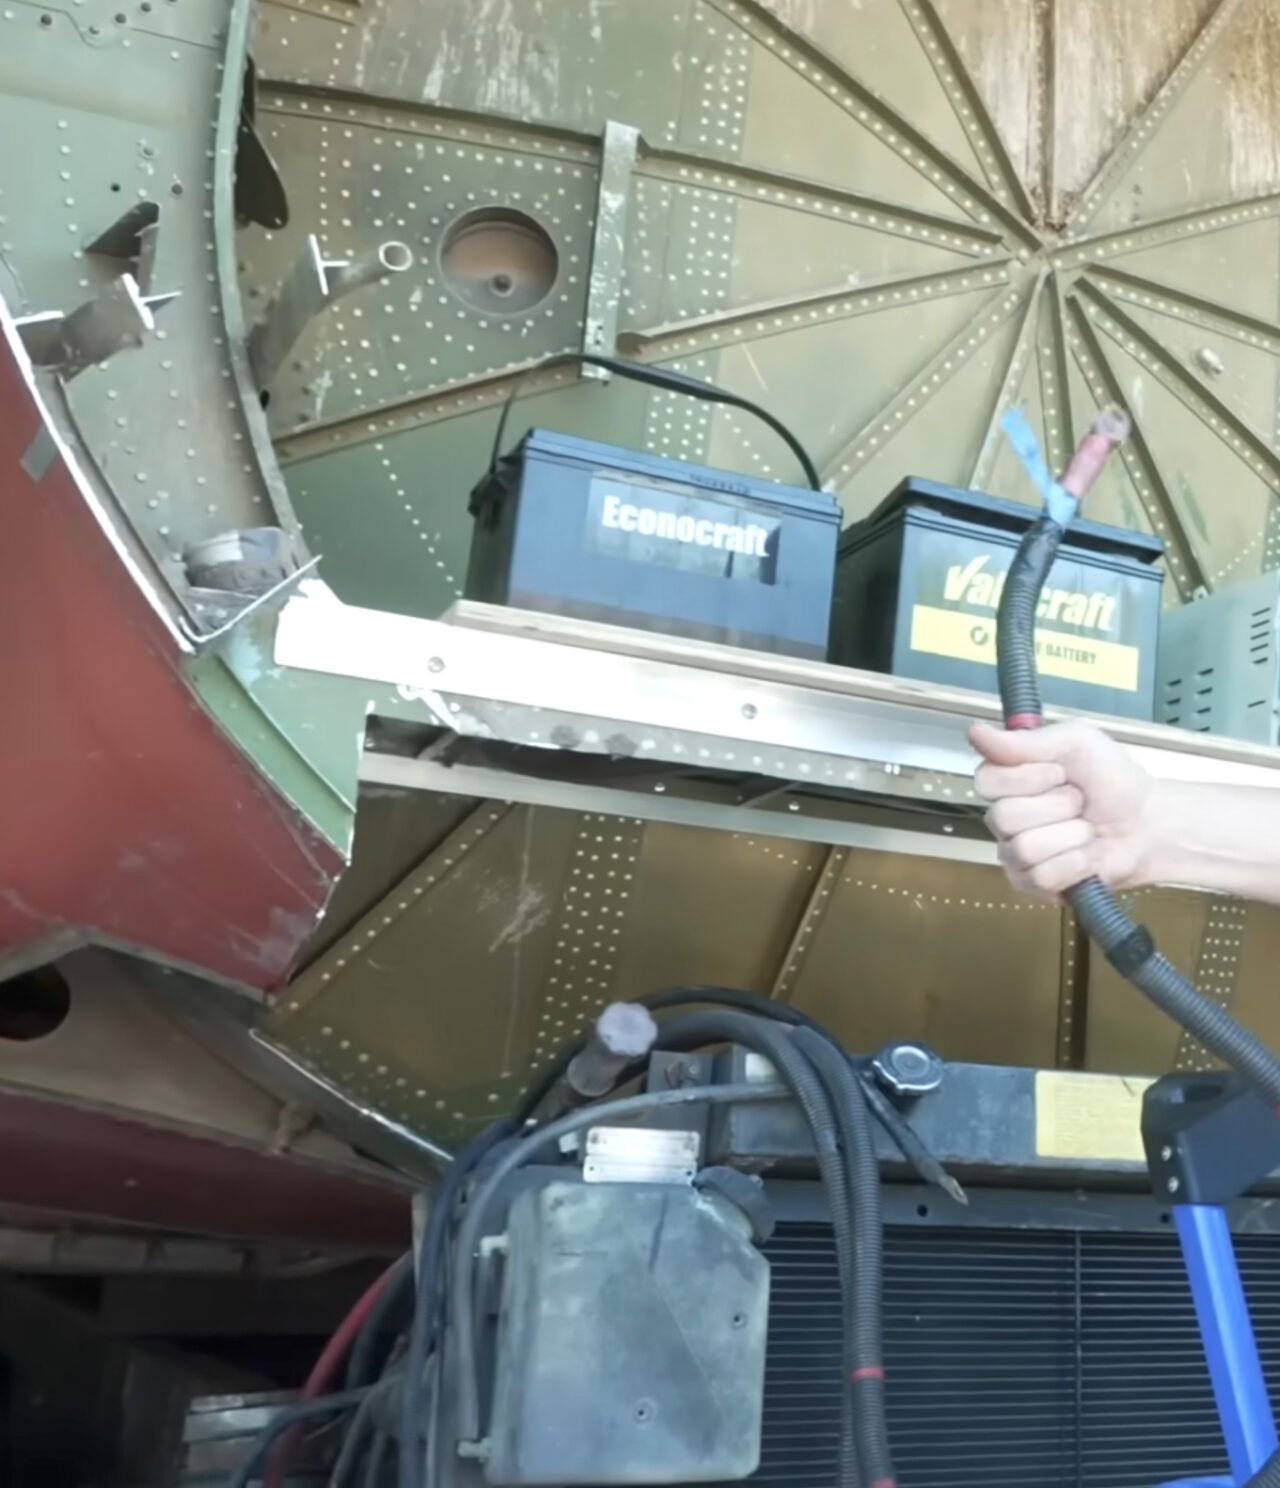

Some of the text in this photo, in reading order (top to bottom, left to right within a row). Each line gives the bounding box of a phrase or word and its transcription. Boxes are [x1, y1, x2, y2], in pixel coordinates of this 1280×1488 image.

[602, 494, 770, 557] Econocraft
[943, 554, 1116, 632] Valcraft
[1046, 642, 1097, 665] BATTERY
